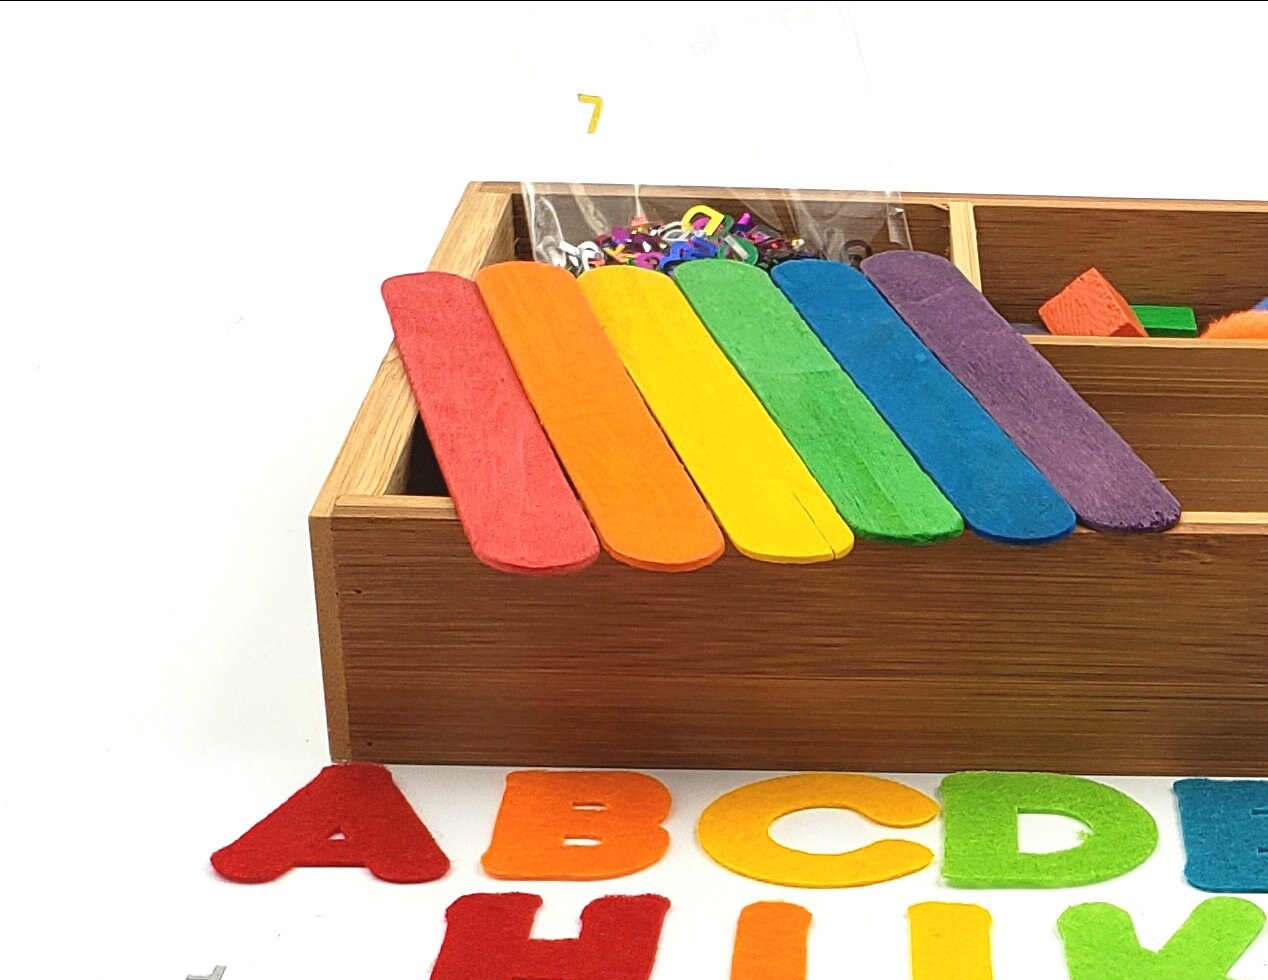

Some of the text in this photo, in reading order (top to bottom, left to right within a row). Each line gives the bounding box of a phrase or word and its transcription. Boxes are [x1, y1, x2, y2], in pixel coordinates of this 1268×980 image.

[576, 93, 604, 134] 7
[210, 762, 450, 882] A
[482, 771, 673, 880] B
[697, 772, 934, 888] C
[939, 772, 1159, 887] D
